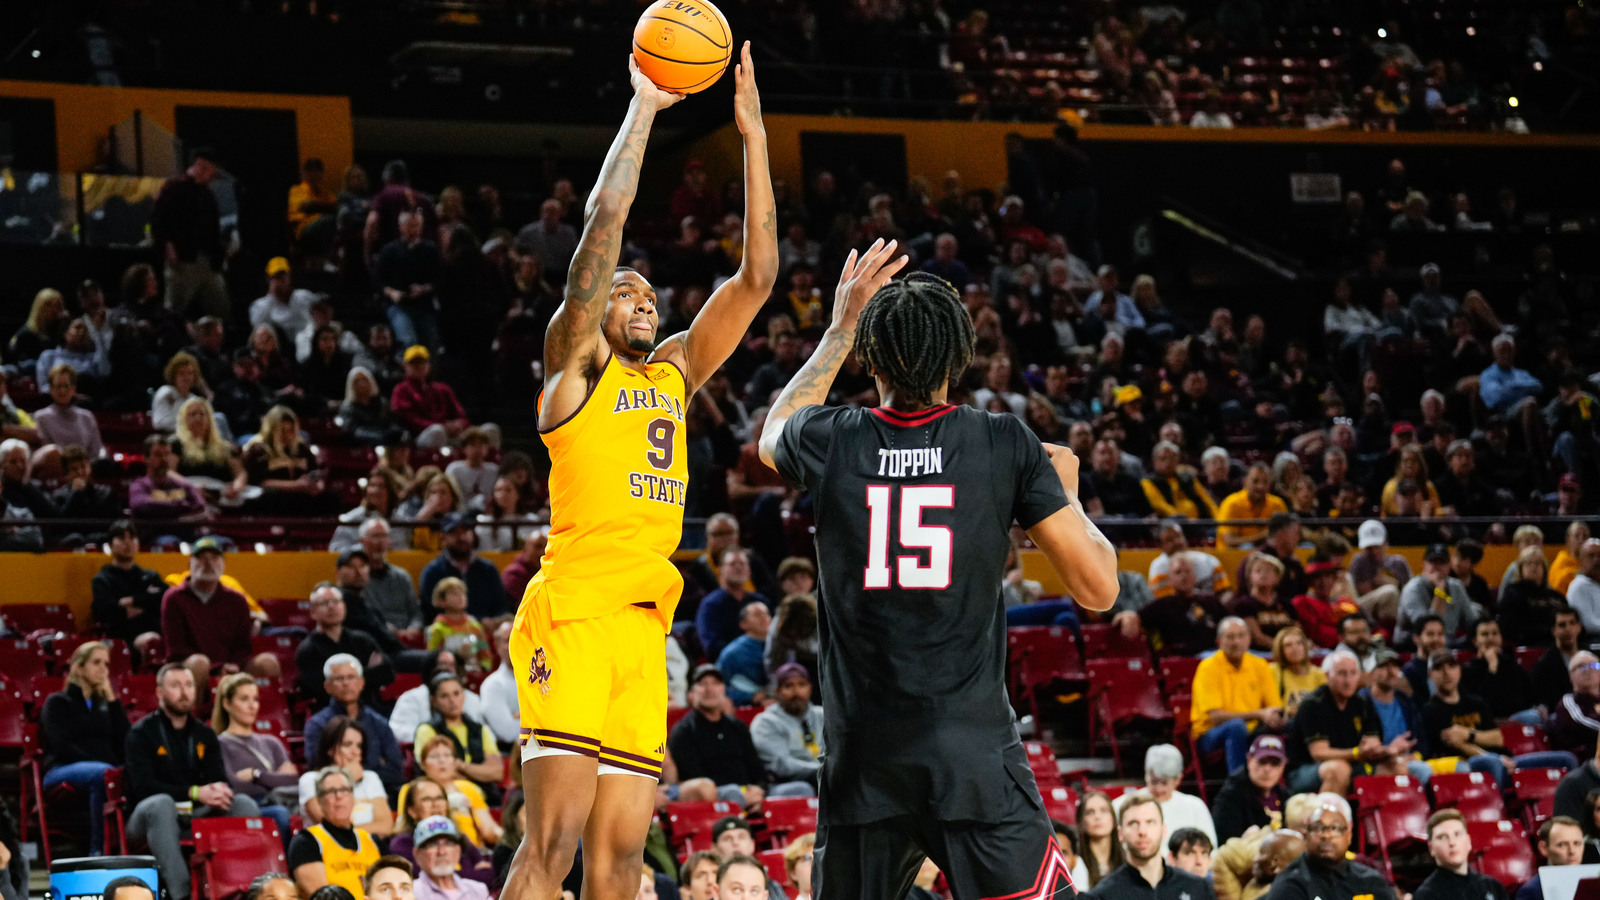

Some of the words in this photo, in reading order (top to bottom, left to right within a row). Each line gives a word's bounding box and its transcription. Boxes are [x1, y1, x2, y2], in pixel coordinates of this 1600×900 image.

[662, 0, 702, 17] EVO
[646, 417, 677, 471] 9
[877, 447, 943, 477] TOPPIN
[629, 472, 685, 507] STATE
[863, 484, 955, 590] 15
